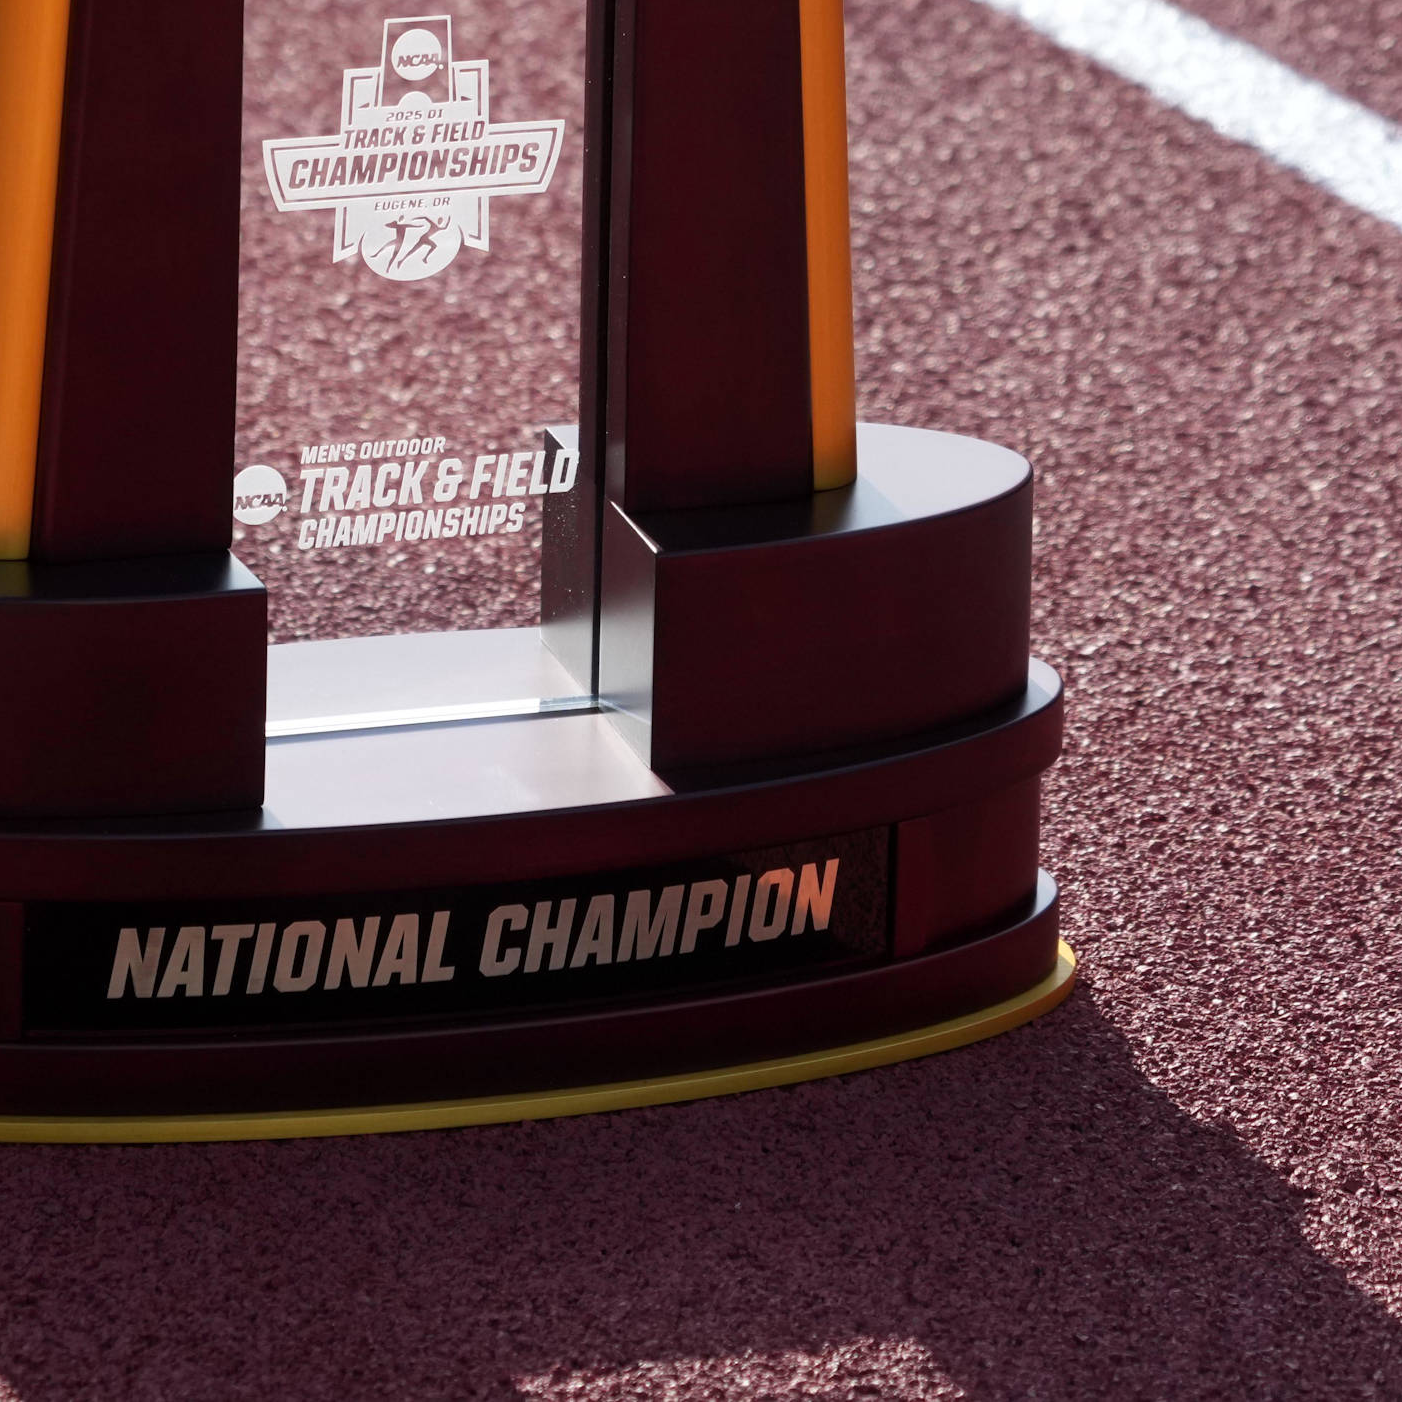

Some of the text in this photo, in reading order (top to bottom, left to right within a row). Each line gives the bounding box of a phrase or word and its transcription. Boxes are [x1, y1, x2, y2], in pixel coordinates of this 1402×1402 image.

[397, 53, 439, 69] NCAA
[386, 110, 422, 122] 2025
[344, 120, 485, 150] TRACK & FIELD
[288, 142, 540, 190] CHAMPIONSHIPS
[300, 436, 446, 464] MEN'S OUTDOOR
[300, 451, 580, 514] TRACK & FIELD
[235, 492, 286, 511] NCAA
[298, 502, 526, 549] CHAMPIONSHIPS
[107, 858, 840, 998] NATIONAL CHAMPION
